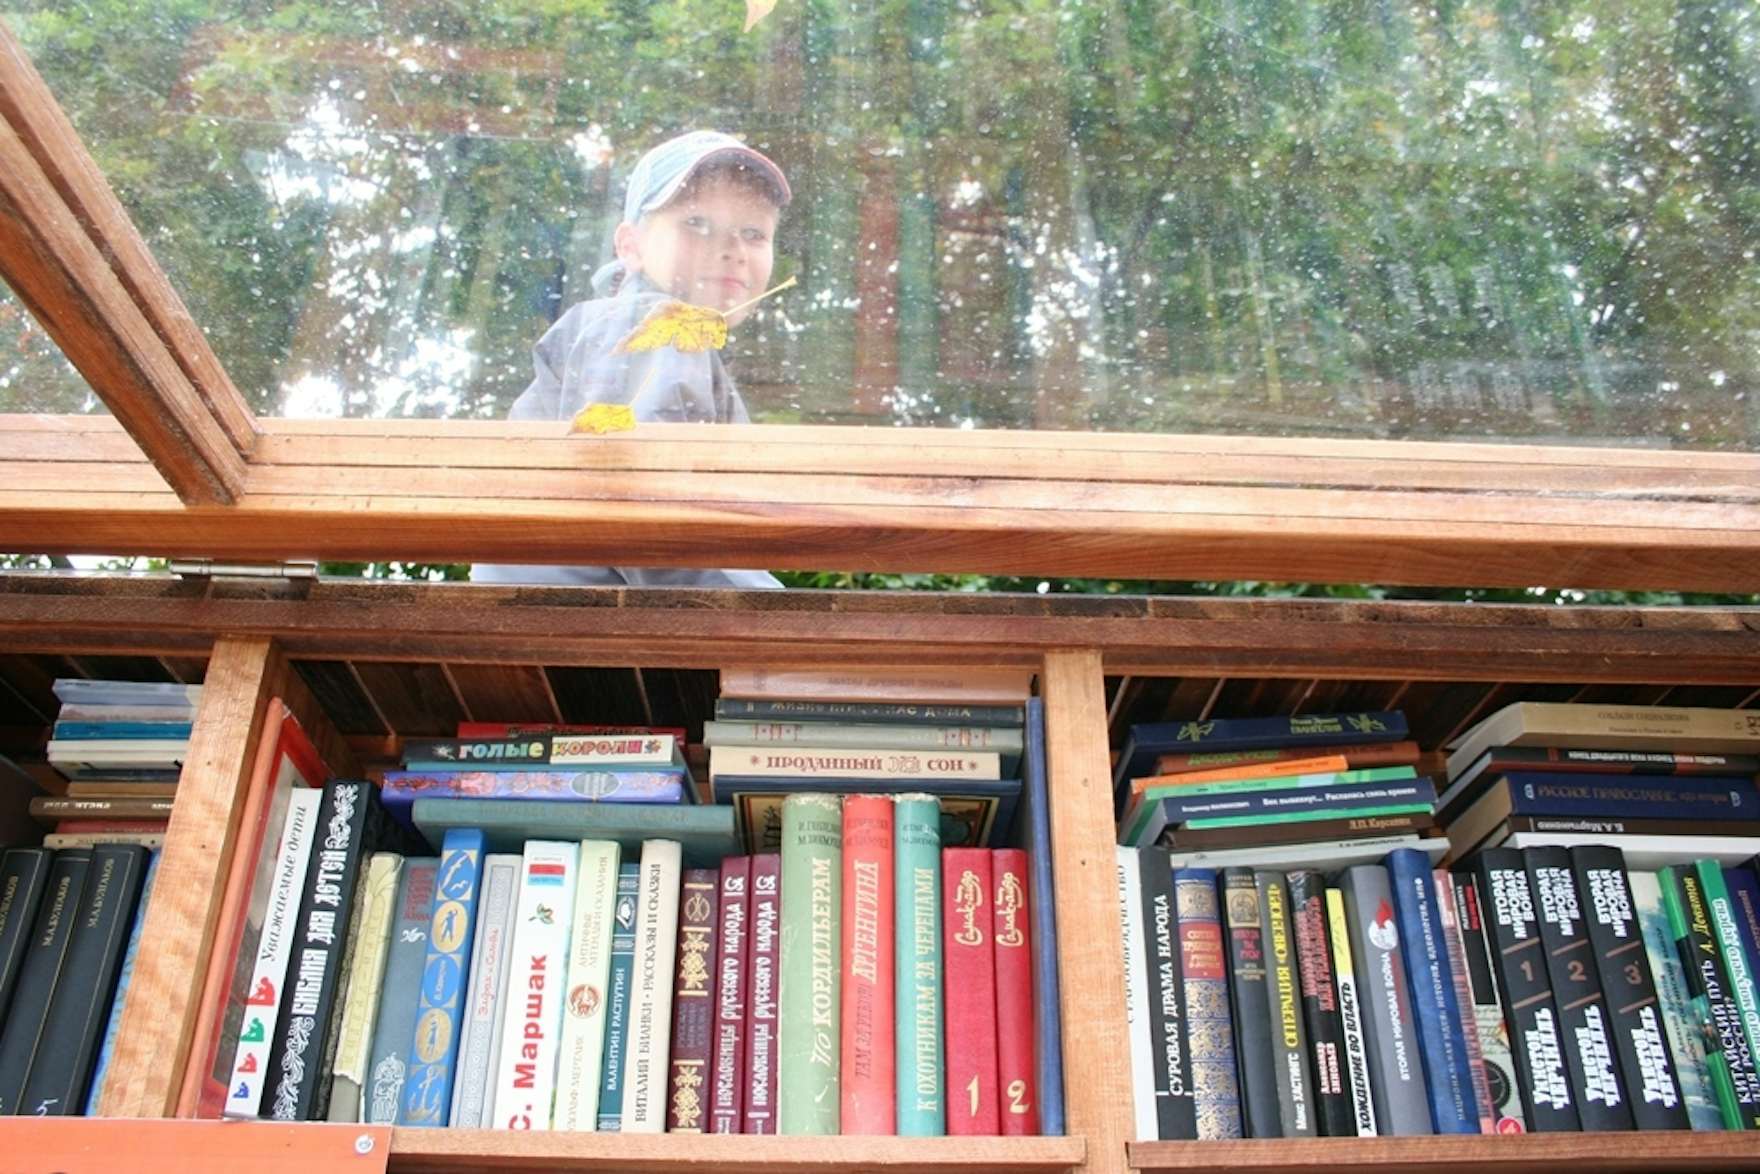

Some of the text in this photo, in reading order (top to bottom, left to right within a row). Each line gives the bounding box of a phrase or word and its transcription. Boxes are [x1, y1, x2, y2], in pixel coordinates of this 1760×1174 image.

[766, 754, 964, 771] ПРОДАННЫЙ СОН
[260, 805, 307, 963] Уважаемые дети
[914, 867, 935, 955] ЧЕРЕПАМИ
[1490, 870, 1511, 925] ВТОРАЯ
[1500, 870, 1528, 938] МИРОВАЯ
[1515, 870, 1535, 921] ВОЙНА
[1536, 868, 1558, 923] ВТОРАЯ
[1548, 868, 1574, 935] МИРОВАЯ
[1561, 868, 1581, 919] ВОЙНА
[1587, 869, 1611, 924] ВТОРАЯ
[1600, 869, 1628, 937] МИРОВАЯ
[1613, 869, 1633, 920] ВОЙНА
[1683, 876, 1716, 954] А. Девятов
[292, 849, 347, 1015] БИБЛИЯ ДЛЯ ДЕТЕЙ
[812, 858, 832, 1027] КОРДИЛЬЕРАМ
[852, 860, 879, 984] АРГЕНТИНА
[1712, 899, 1734, 945] дерева
[634, 863, 661, 1121] ВИТАЛИЙ БИАНКИ РАССКАЗЫ И СКАЗКИ
[916, 960, 935, 979] ЗА
[1154, 895, 1184, 1095] СУРОВАЯ ДРАМА НАРОДА
[1521, 960, 1534, 981] 1
[1568, 960, 1587, 981] 2
[1625, 963, 1642, 985] 3
[1728, 947, 1754, 1010] могучего
[513, 955, 547, 1088] Маршак
[607, 968, 625, 1090] ВАЛЕНТИН РАСПУТИН
[916, 984, 937, 1094] ОХОТНИКАМ
[1277, 966, 1299, 1048] ОПЕРАЦИЯ
[1381, 952, 1410, 1080] ВТОРАЯ МИРОВАЯ ВОЙНА
[1701, 959, 1753, 1103] КИТАЙСКИЙ ПУТЬ
[1726, 996, 1755, 1066] РОССИИ?
[1288, 1052, 1307, 1129] Макс ХАСТИНГС
[1326, 1043, 1341, 1094] ЗИНОВЬЕВ
[1341, 982, 1372, 1131] ХОЖДЕНИЕ ВО ВЛАСТЬ
[1444, 1042, 1465, 1121] НАЦИОНАЛЬНАЯ
[1535, 1008, 1569, 1109] ЧЕРЧИЛЛЬ
[1585, 1005, 1621, 1106] ЧЕРЧИЛЛЬ
[1641, 1006, 1679, 1107] ЧЕРЧИЛЛЬ
[918, 1098, 937, 1111] К
[966, 1074, 979, 1117] 1
[1007, 1079, 1030, 1114] 2
